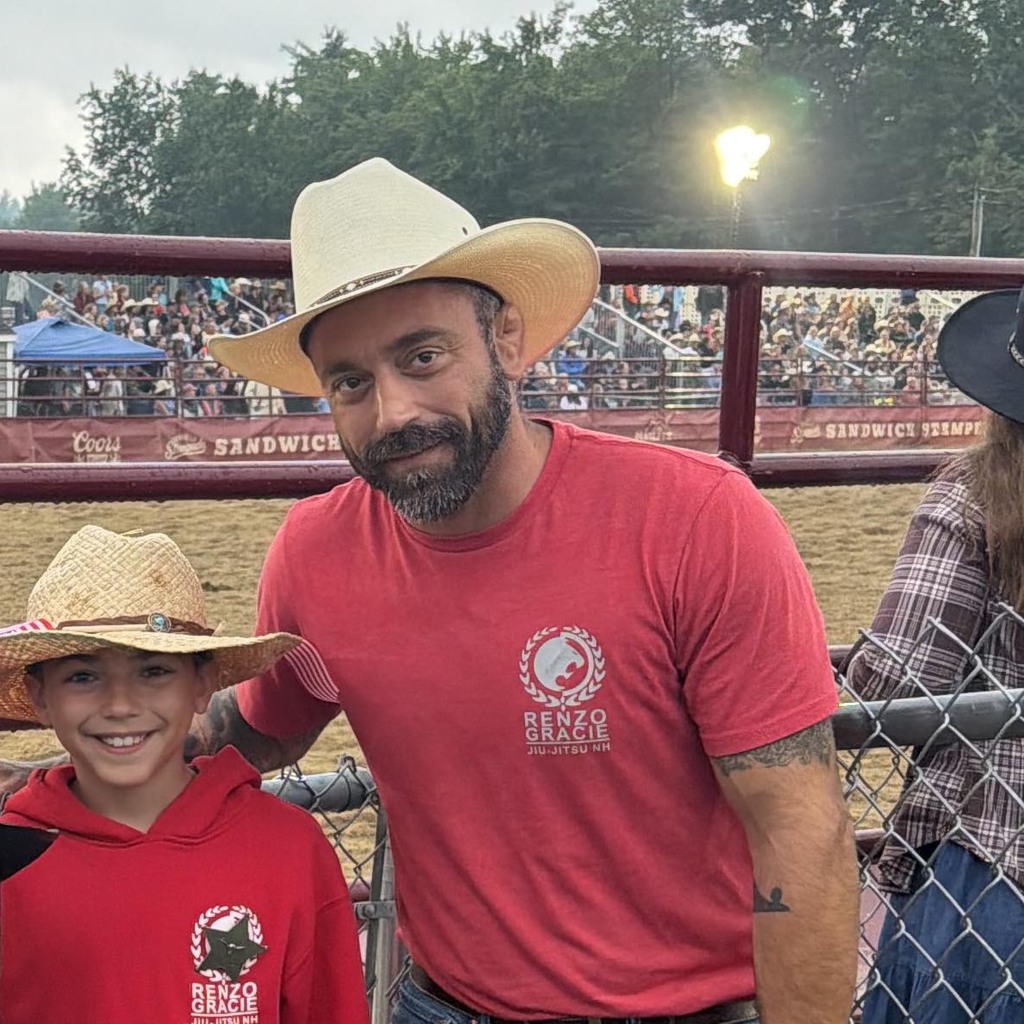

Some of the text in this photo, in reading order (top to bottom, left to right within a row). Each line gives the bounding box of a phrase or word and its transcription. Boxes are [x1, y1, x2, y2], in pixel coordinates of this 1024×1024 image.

[72, 430, 121, 452] Coors
[214, 434, 342, 456] SANDWICH
[524, 709, 607, 727] RENZO
[525, 724, 610, 741] GRACIE
[527, 742, 611, 755] JIU-JITSU NH
[191, 981, 258, 999] RENZO
[191, 997, 258, 1013] GRACIE
[243, 1015, 258, 1024] NH
